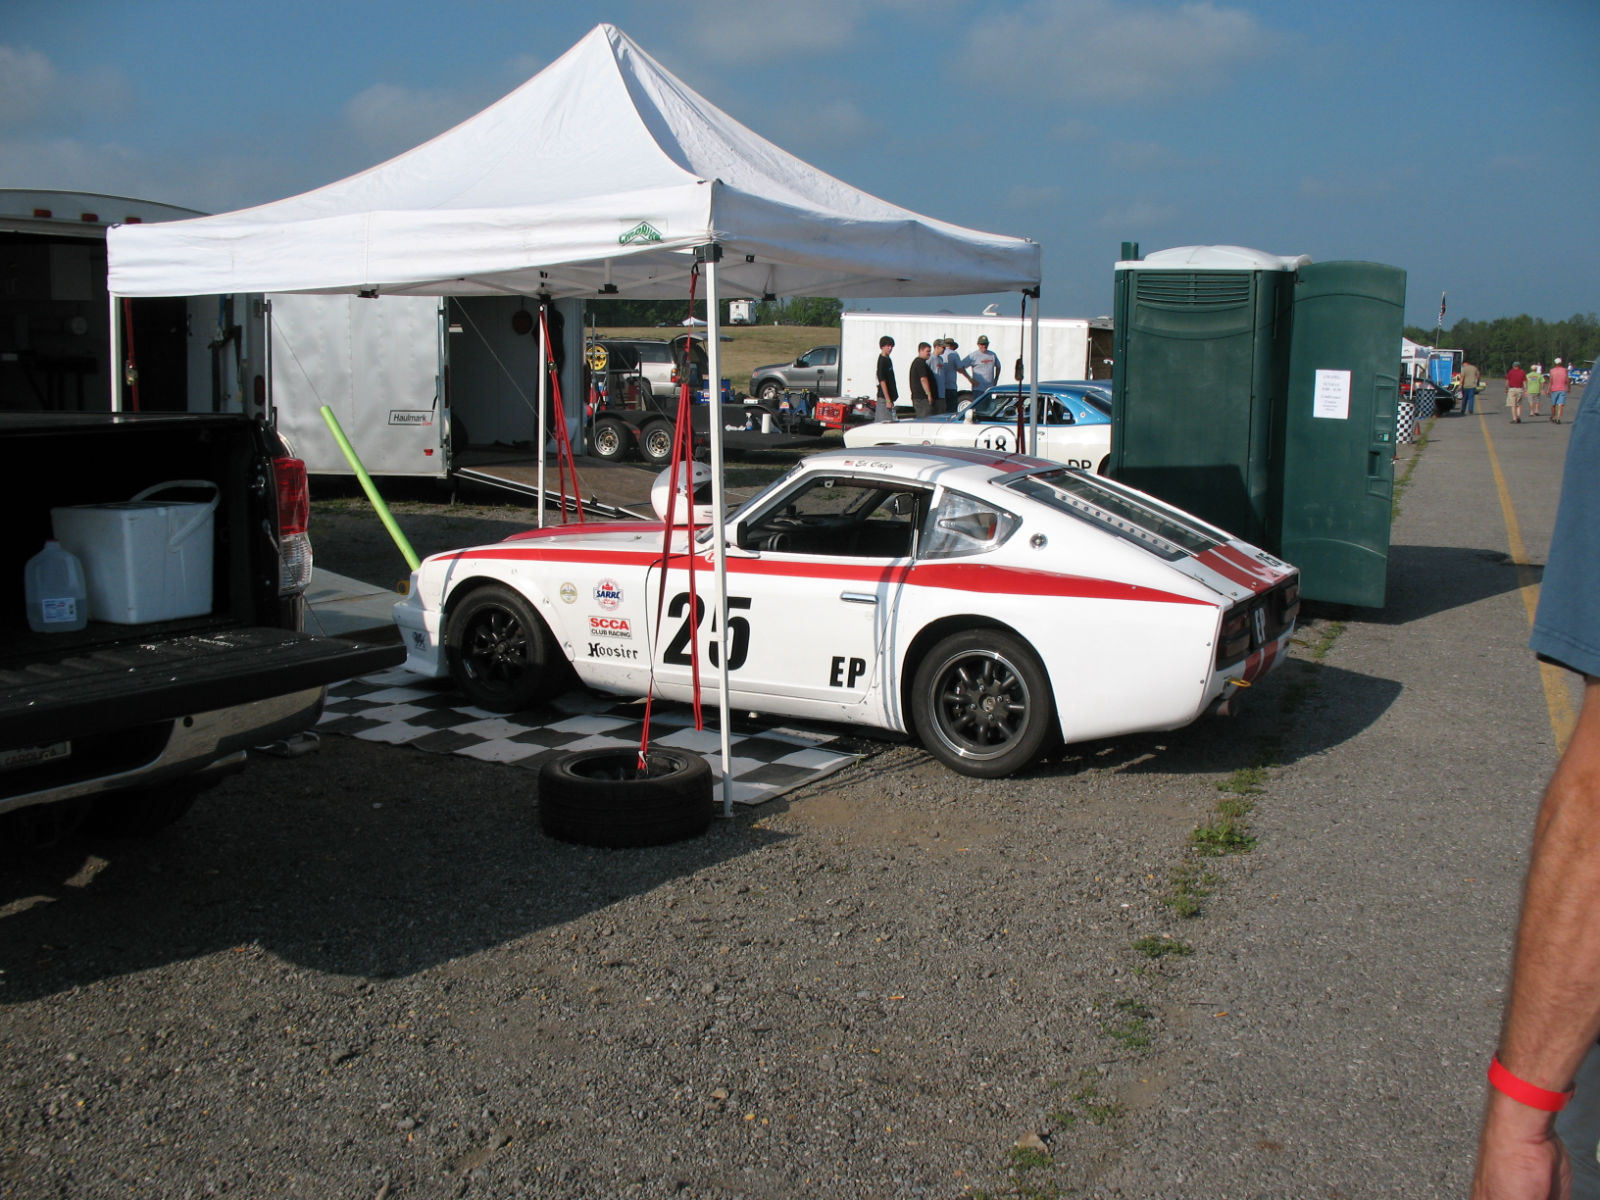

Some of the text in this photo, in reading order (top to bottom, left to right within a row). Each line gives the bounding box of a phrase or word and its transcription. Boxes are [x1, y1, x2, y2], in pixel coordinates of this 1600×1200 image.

[393, 413, 427, 422] Haulmark
[984, 434, 1007, 452] 18
[590, 617, 630, 631] SCCA
[591, 628, 631, 638] CLUB RACING
[663, 591, 752, 671] 25
[587, 642, 639, 660] Hoosier
[829, 656, 867, 688] EP
